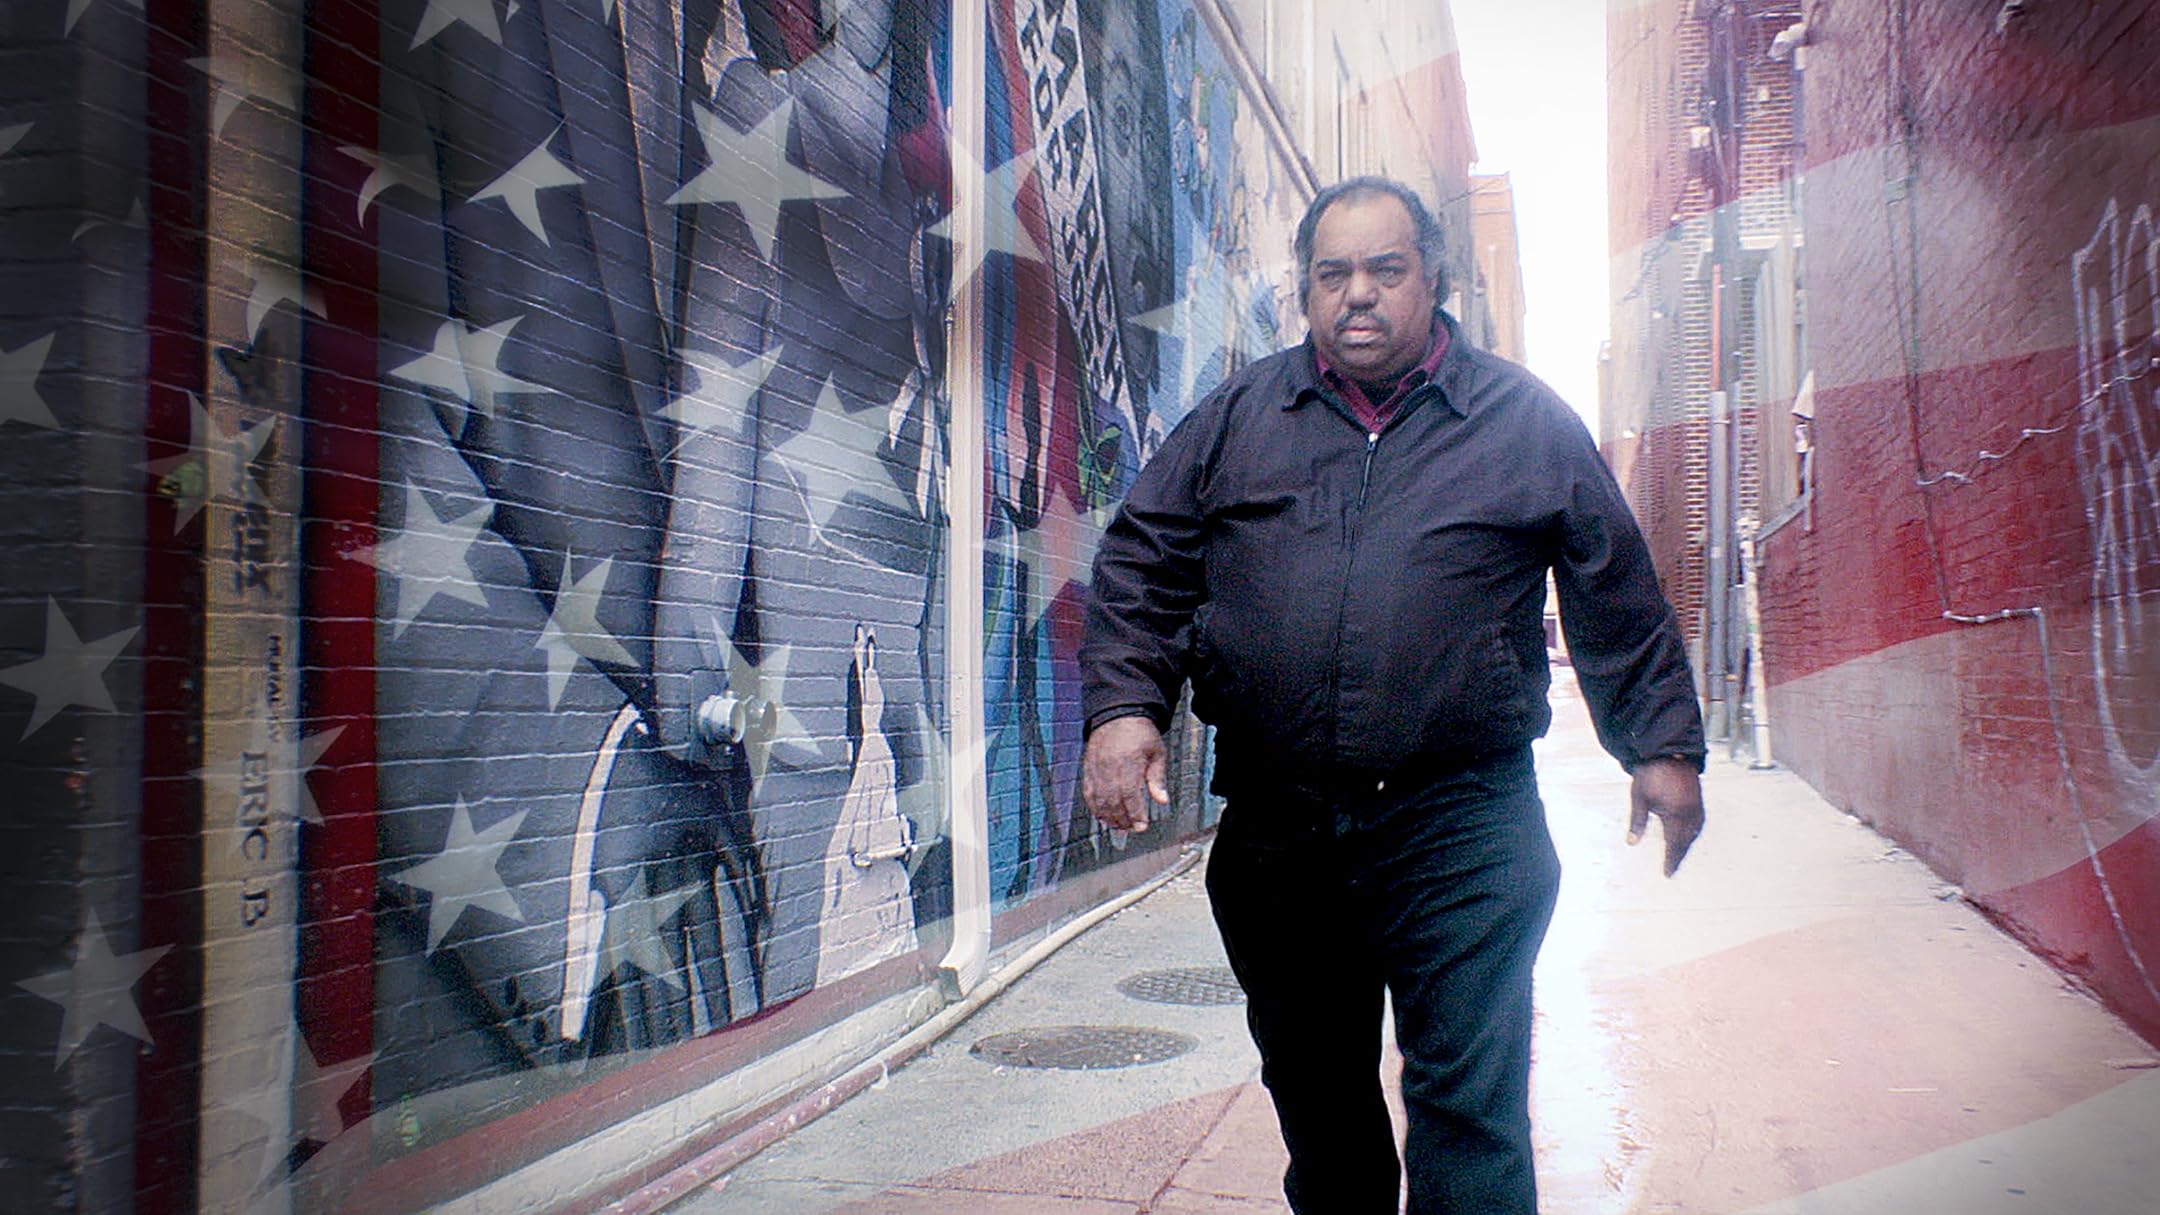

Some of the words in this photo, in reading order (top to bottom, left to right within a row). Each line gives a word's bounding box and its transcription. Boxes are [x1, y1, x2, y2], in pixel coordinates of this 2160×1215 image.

[1020, 2, 1063, 192] FOR
[240, 752, 268, 862] ERIC
[240, 888, 271, 929] B
